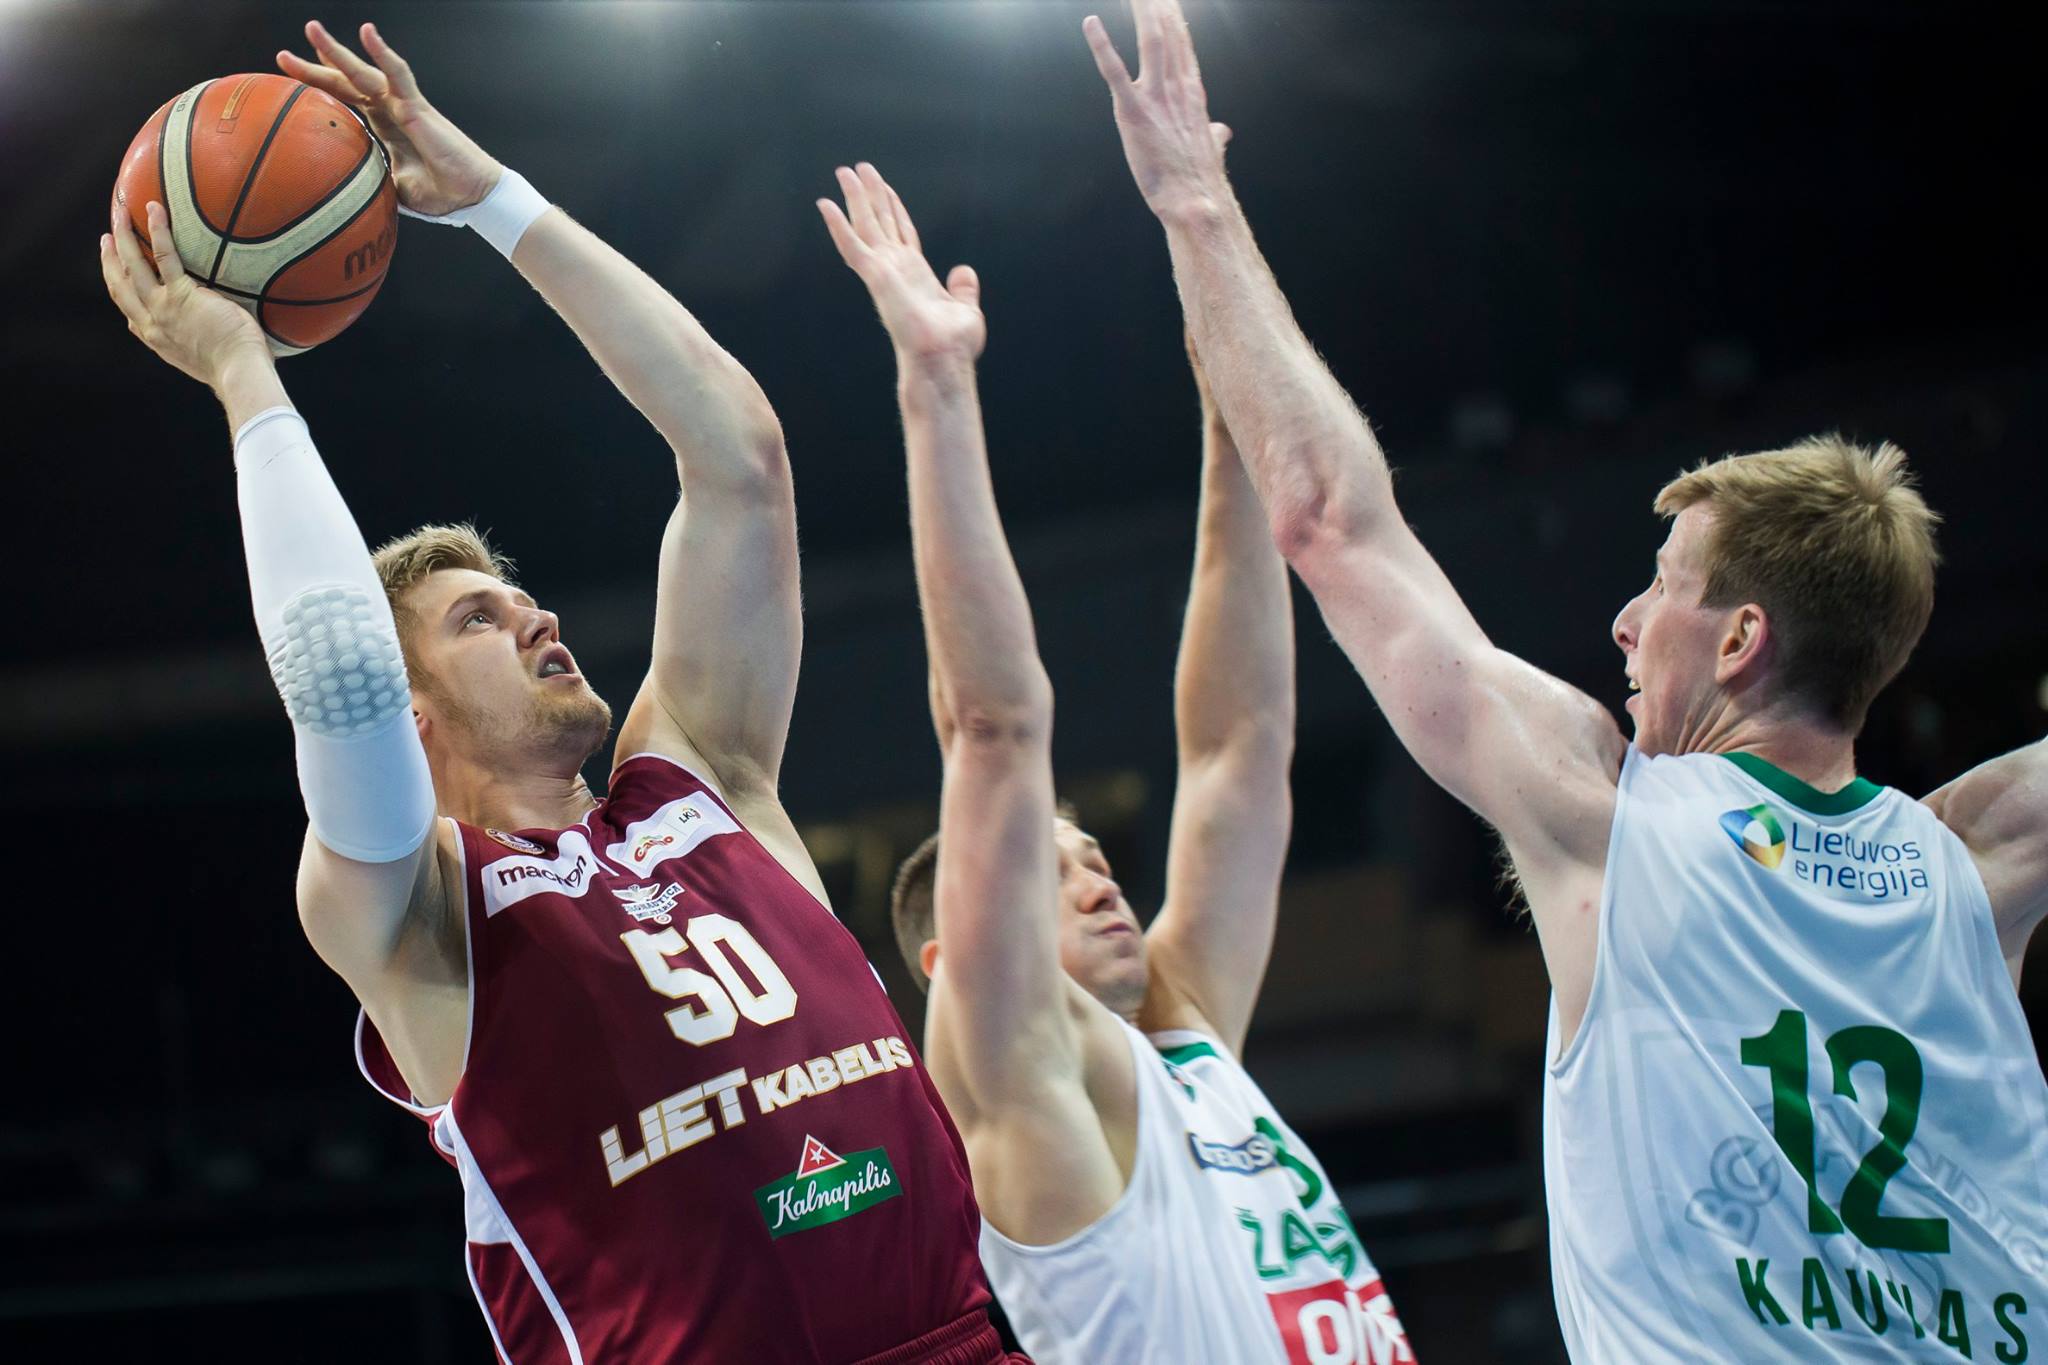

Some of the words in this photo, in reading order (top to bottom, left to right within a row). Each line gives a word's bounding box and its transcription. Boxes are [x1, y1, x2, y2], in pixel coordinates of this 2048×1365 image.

[1791, 822, 1921, 864] Lietuvos
[1795, 857, 1929, 898] energija
[620, 913, 797, 1047] 50
[599, 1067, 748, 1188] LIET
[751, 1036, 914, 1115] KABELIS
[1741, 1009, 1951, 1254] 12
[767, 1160, 892, 1230] Kalnapilis
